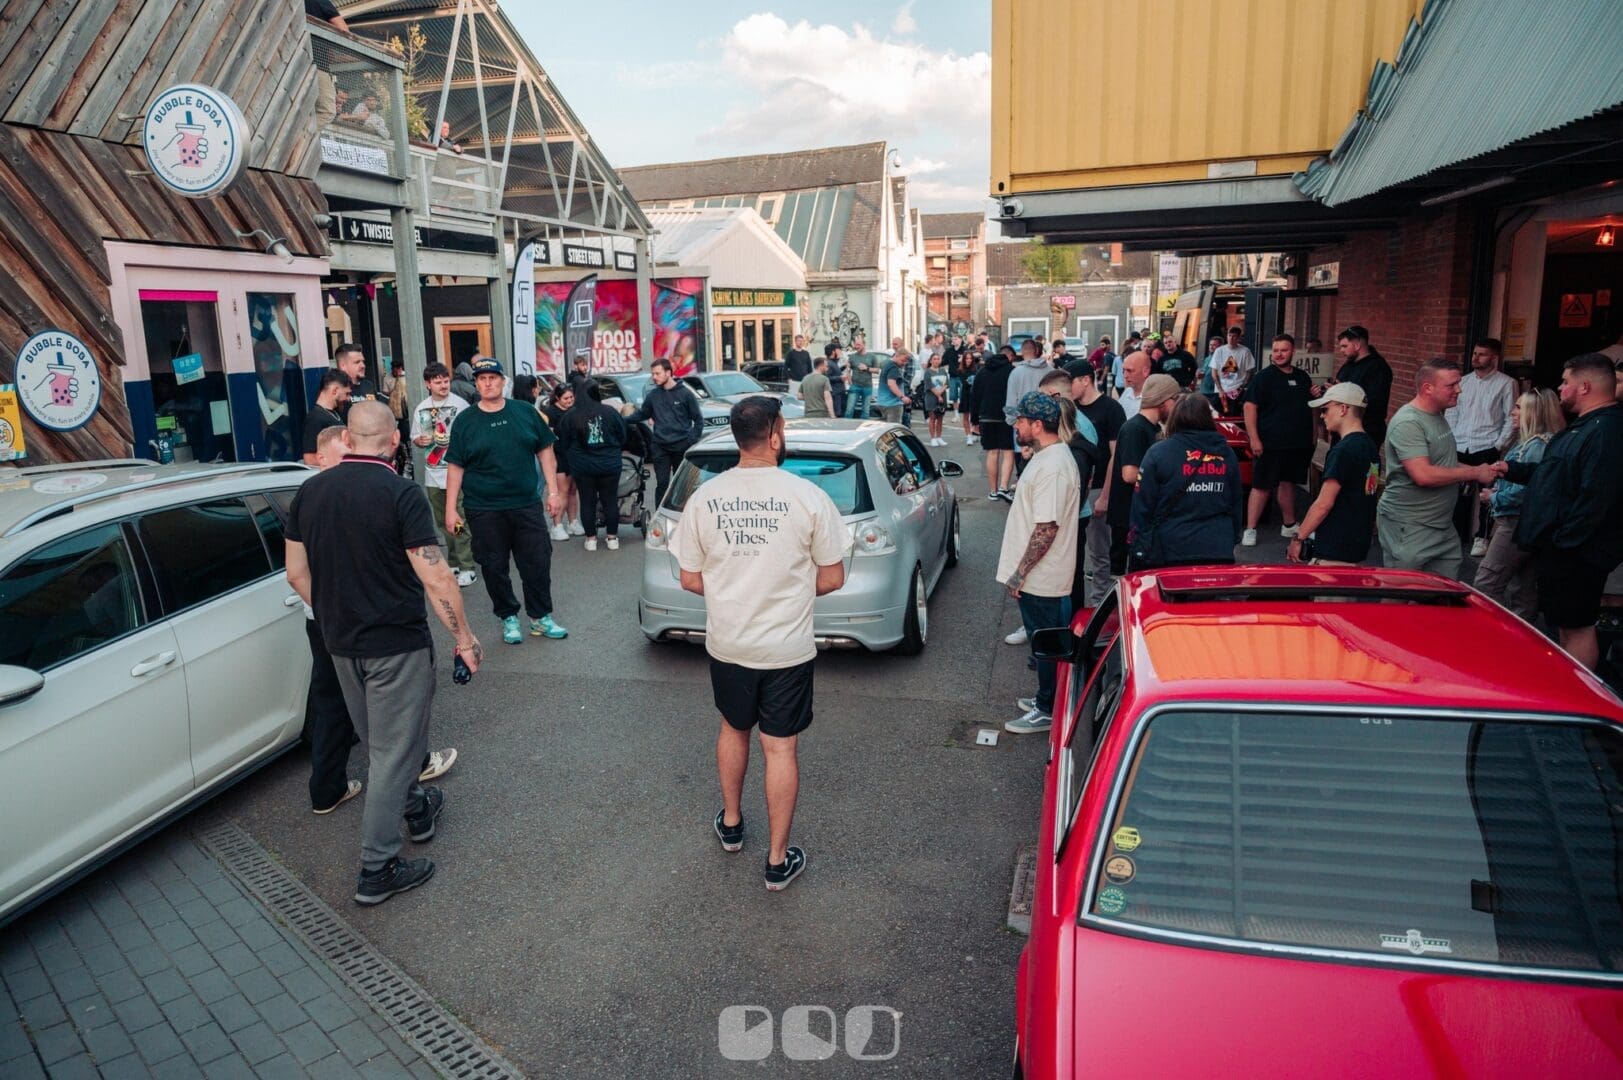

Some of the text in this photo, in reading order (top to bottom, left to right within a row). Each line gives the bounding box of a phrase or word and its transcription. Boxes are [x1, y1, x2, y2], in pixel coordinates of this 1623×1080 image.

[154, 96, 222, 128] BUBBLE BOBA
[568, 247, 602, 266] STREET FOOD
[593, 330, 636, 349] FOOD
[25, 337, 90, 369] BUBBLE BOBA
[592, 348, 637, 368] VIBES
[1186, 482, 1214, 492] Mobil
[707, 497, 791, 516] Wednesday
[717, 514, 779, 532] Evening
[724, 530, 768, 544] Vibes.
